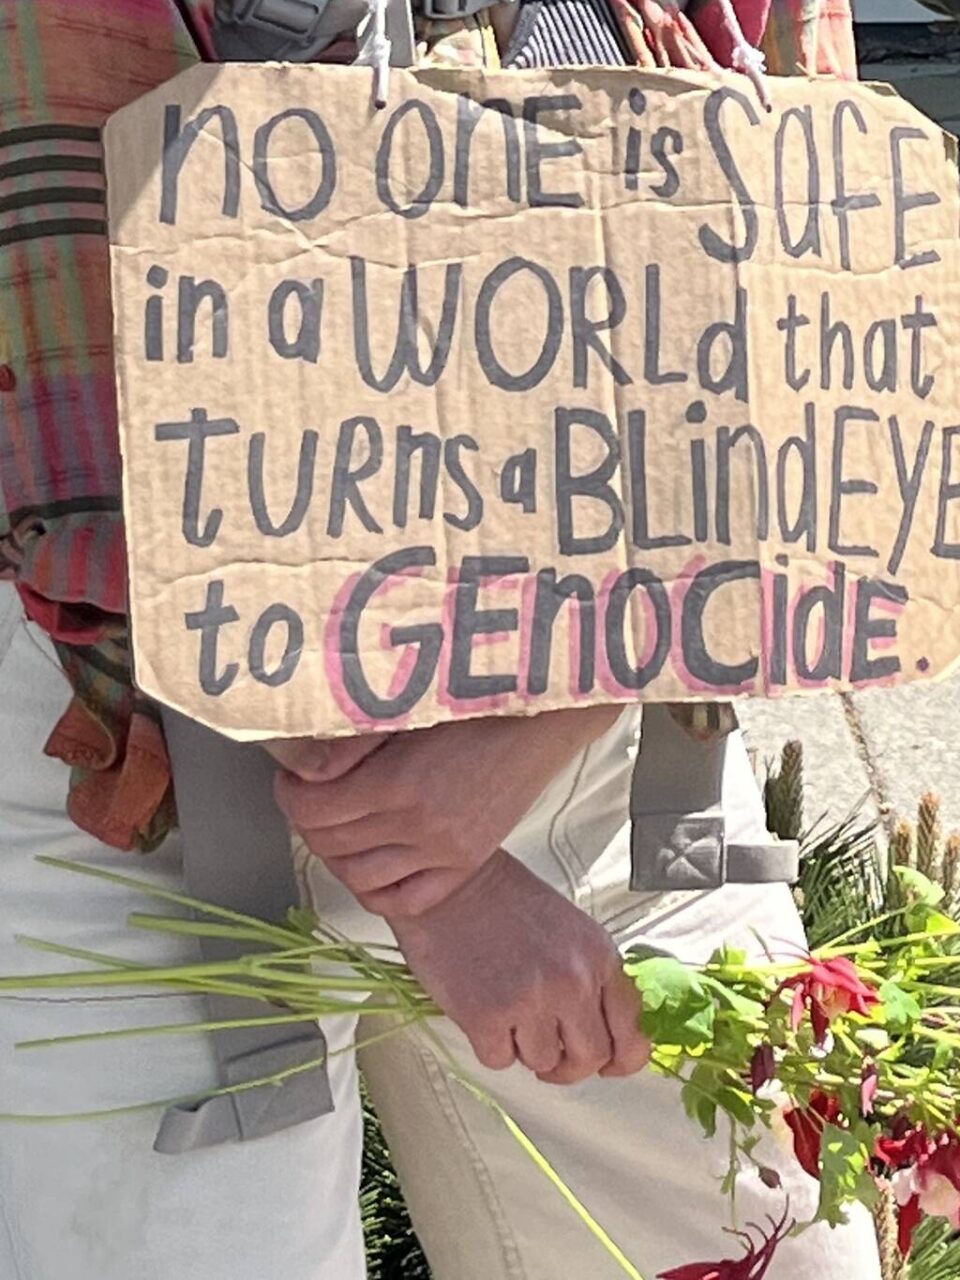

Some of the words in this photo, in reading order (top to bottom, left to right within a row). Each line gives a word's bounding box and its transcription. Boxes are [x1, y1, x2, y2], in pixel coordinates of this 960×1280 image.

[625, 87, 684, 198] is
[145, 264, 229, 364] in
[267, 277, 325, 364] a
[777, 291, 938, 400] that
[500, 447, 537, 514] a
[184, 579, 305, 697] to
